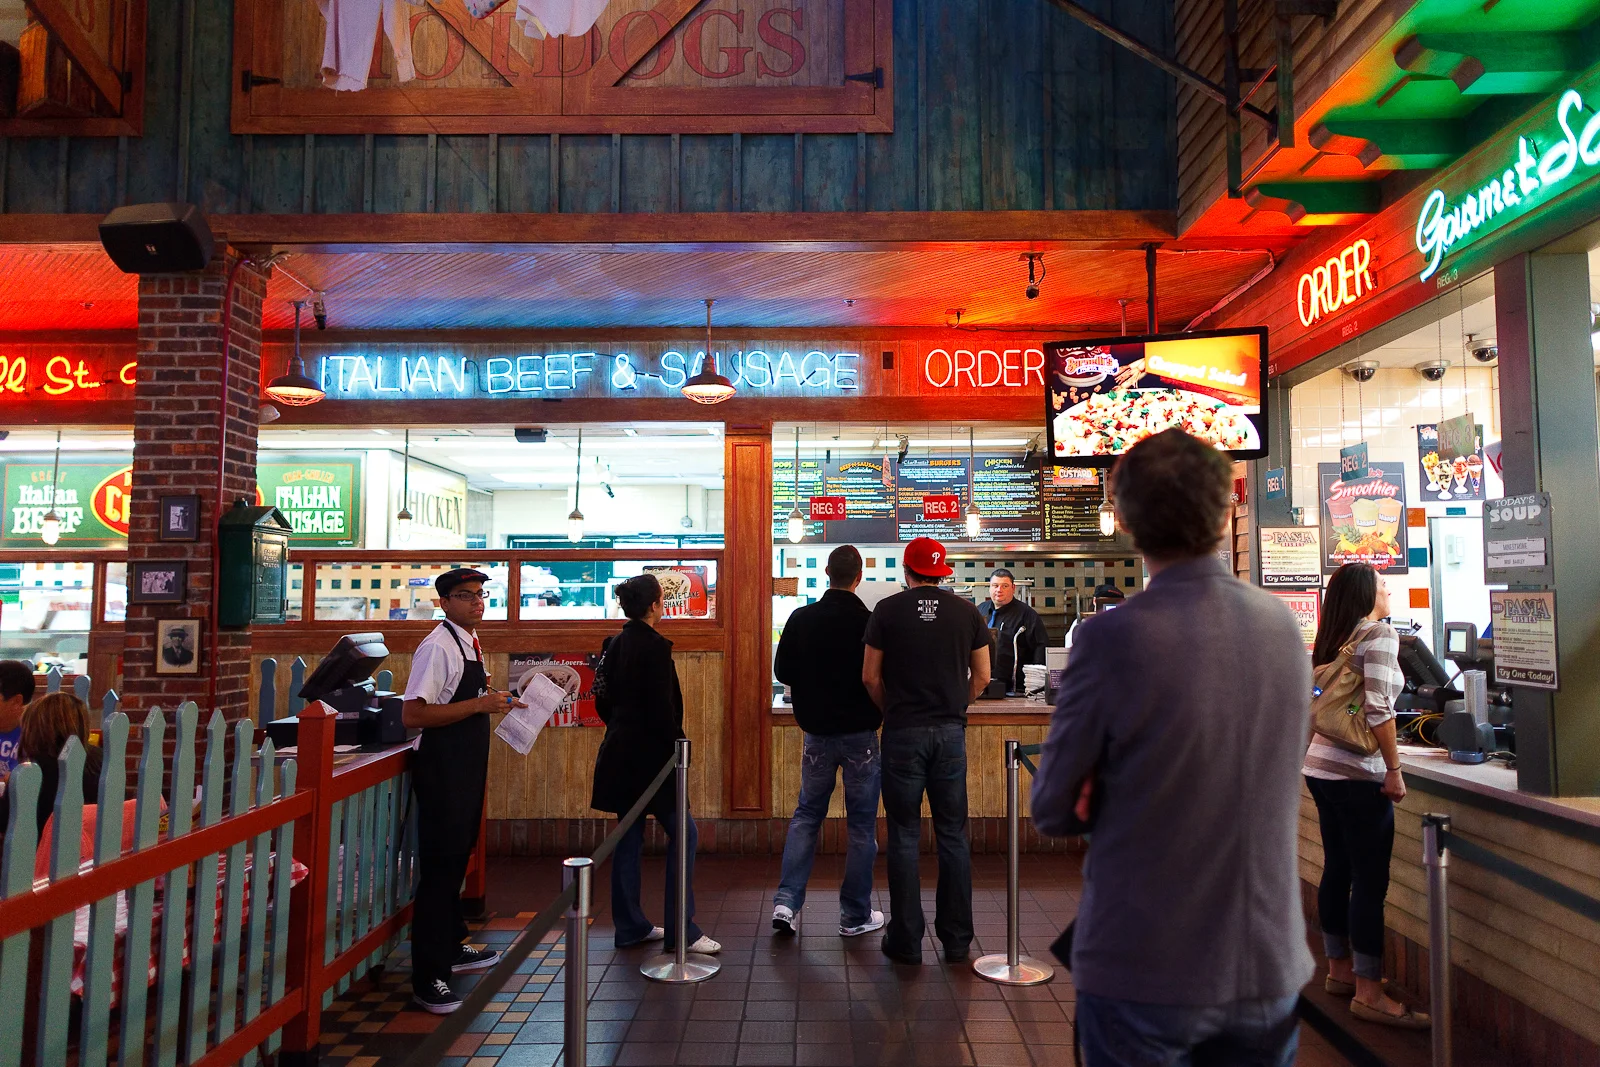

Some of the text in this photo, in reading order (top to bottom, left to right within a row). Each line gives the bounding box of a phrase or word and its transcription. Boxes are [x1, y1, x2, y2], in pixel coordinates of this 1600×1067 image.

[1415, 135, 1539, 283] Gourmet
[1298, 238, 1373, 327] ORDER
[321, 355, 467, 392] ITALIAN
[486, 352, 596, 394] BEEF
[611, 353, 638, 390] &
[924, 348, 1045, 388] ORDER
[1207, 366, 1247, 387] Salad
[1464, 424, 1472, 444] 3
[1362, 451, 1367, 469] 2
[31, 470, 67, 483] GRET
[1058, 468, 1092, 478] CUSTARD
[18, 484, 79, 505] Italian
[275, 485, 341, 509] ITALIAN
[1330, 479, 1399, 501] Smoothies
[812, 502, 834, 514] REG.
[838, 503, 844, 514] 3
[925, 502, 948, 514] REG.
[950, 500, 958, 513] 2
[1495, 496, 1535, 508] TODAY'S
[282, 510, 345, 534] AUSAGE
[1490, 505, 1542, 522] SOUP
[932, 552, 940, 564] P
[1503, 598, 1551, 620] PASTA
[1499, 668, 1554, 684] Try One Today!
[553, 703, 572, 714] AKE!
